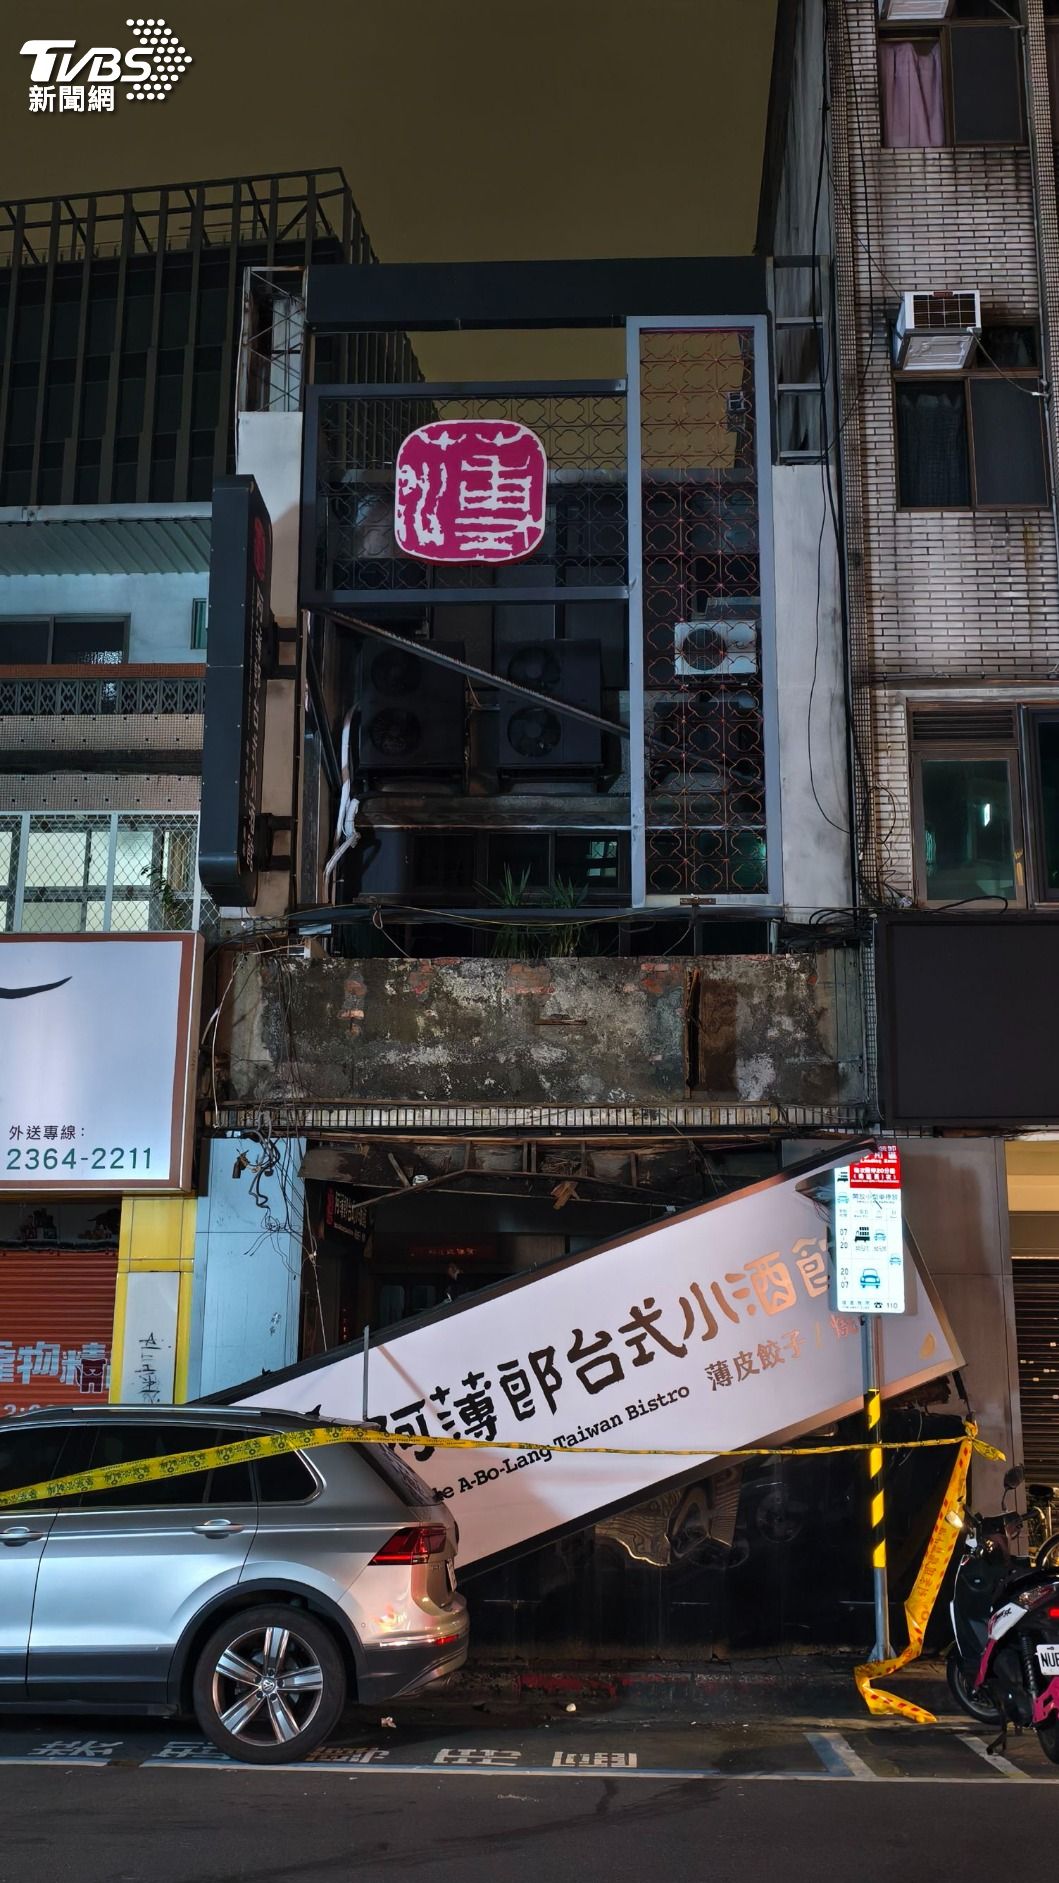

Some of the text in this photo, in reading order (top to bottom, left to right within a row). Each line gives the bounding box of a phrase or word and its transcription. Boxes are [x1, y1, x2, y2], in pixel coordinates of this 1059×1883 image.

[6, 1147, 152, 1170] 2364-2211
[840, 1241, 848, 1249] 20
[840, 1267, 849, 1275] 20
[457, 1445, 553, 1494] A-Bo-Lang
[553, 1413, 624, 1450] Taiwan
[625, 1385, 690, 1421] Bistro
